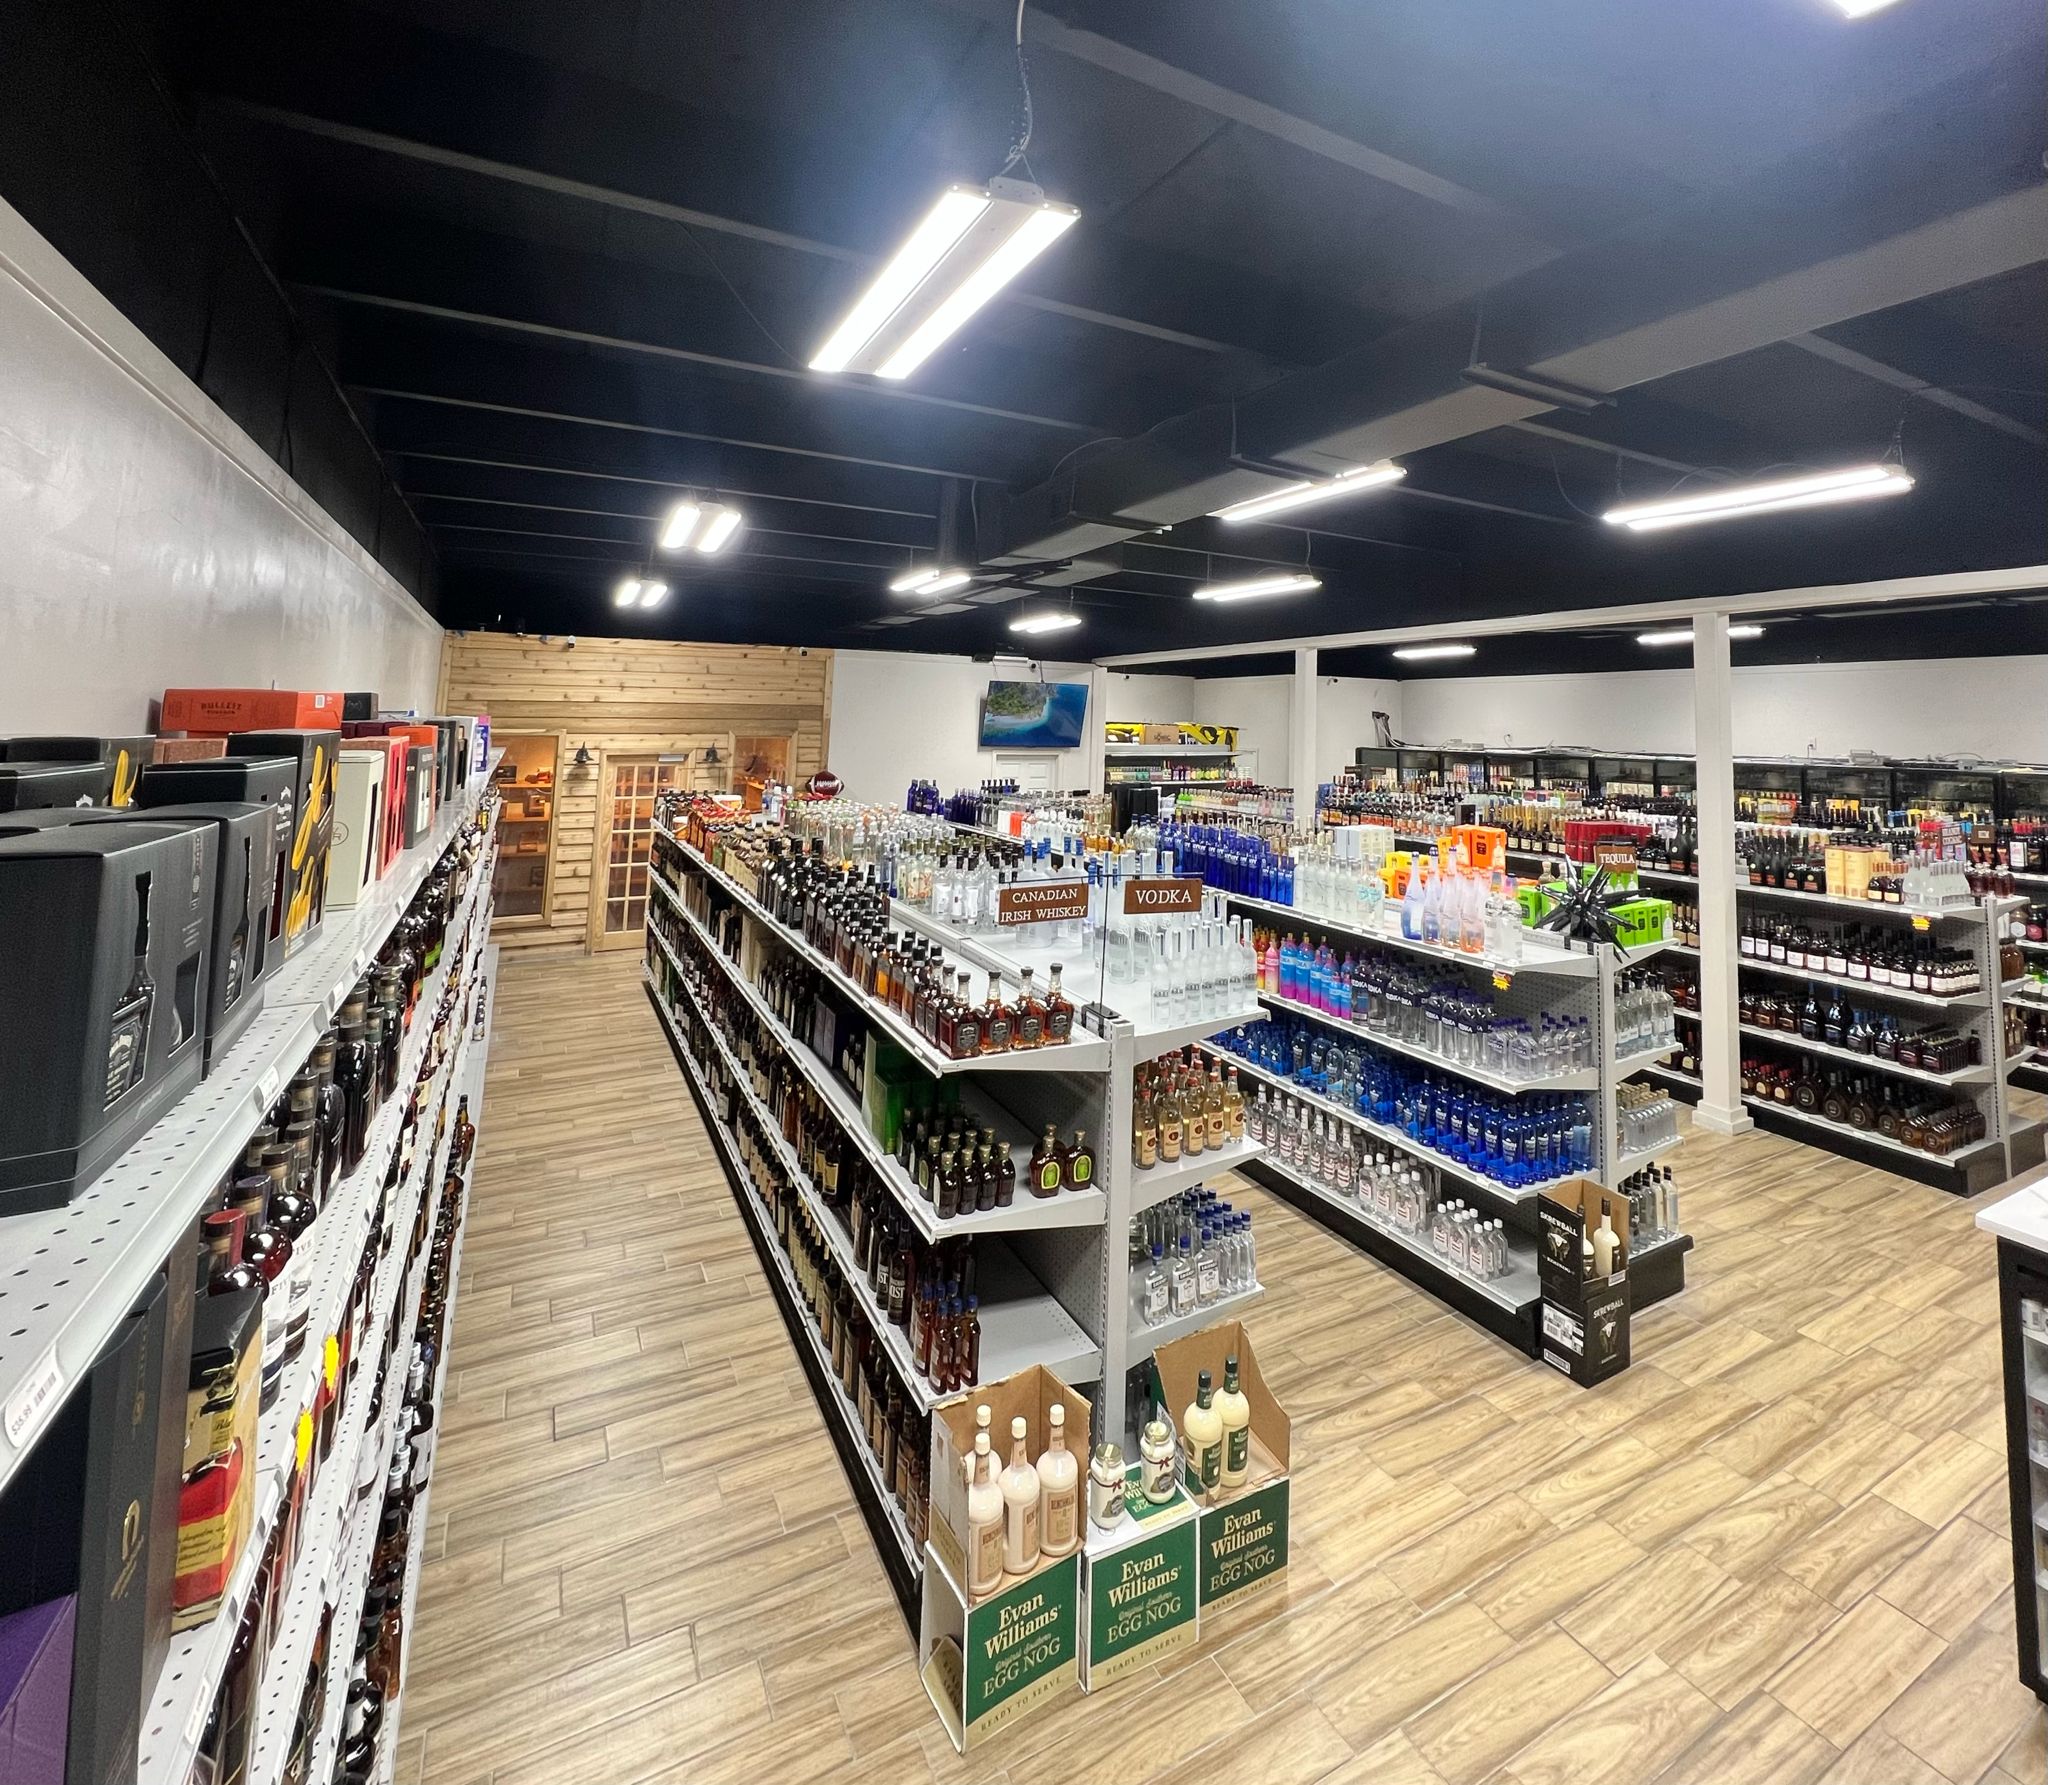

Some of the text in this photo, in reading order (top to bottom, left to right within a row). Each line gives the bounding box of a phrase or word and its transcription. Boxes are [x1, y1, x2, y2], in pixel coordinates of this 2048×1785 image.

[1599, 853, 1635, 865] TEQUILA
[1001, 905, 1087, 923] IRISH WHISKEY
[1012, 888, 1078, 904] CANADIAN
[1135, 889, 1192, 904] VODKA
[1539, 1211, 1578, 1237] SKREWBALL
[1593, 1298, 1625, 1319] SKREWBALL
[1211, 1522, 1274, 1559] Williams
[1223, 1508, 1262, 1536] Evan
[1121, 1553, 1165, 1582] Evan
[1209, 1548, 1275, 1592] EGG NOG
[1107, 1566, 1179, 1608] Williams
[999, 1593, 1044, 1630] Evan
[1107, 1596, 1181, 1644] EGG NOG
[984, 1606, 1060, 1660] Williams
[982, 1659, 1020, 1699] EGG
[1023, 1637, 1061, 1673] NOG
[1106, 1634, 1181, 1676] READY TO SERVE
[981, 1676, 1062, 1732] READY TO SERVE
